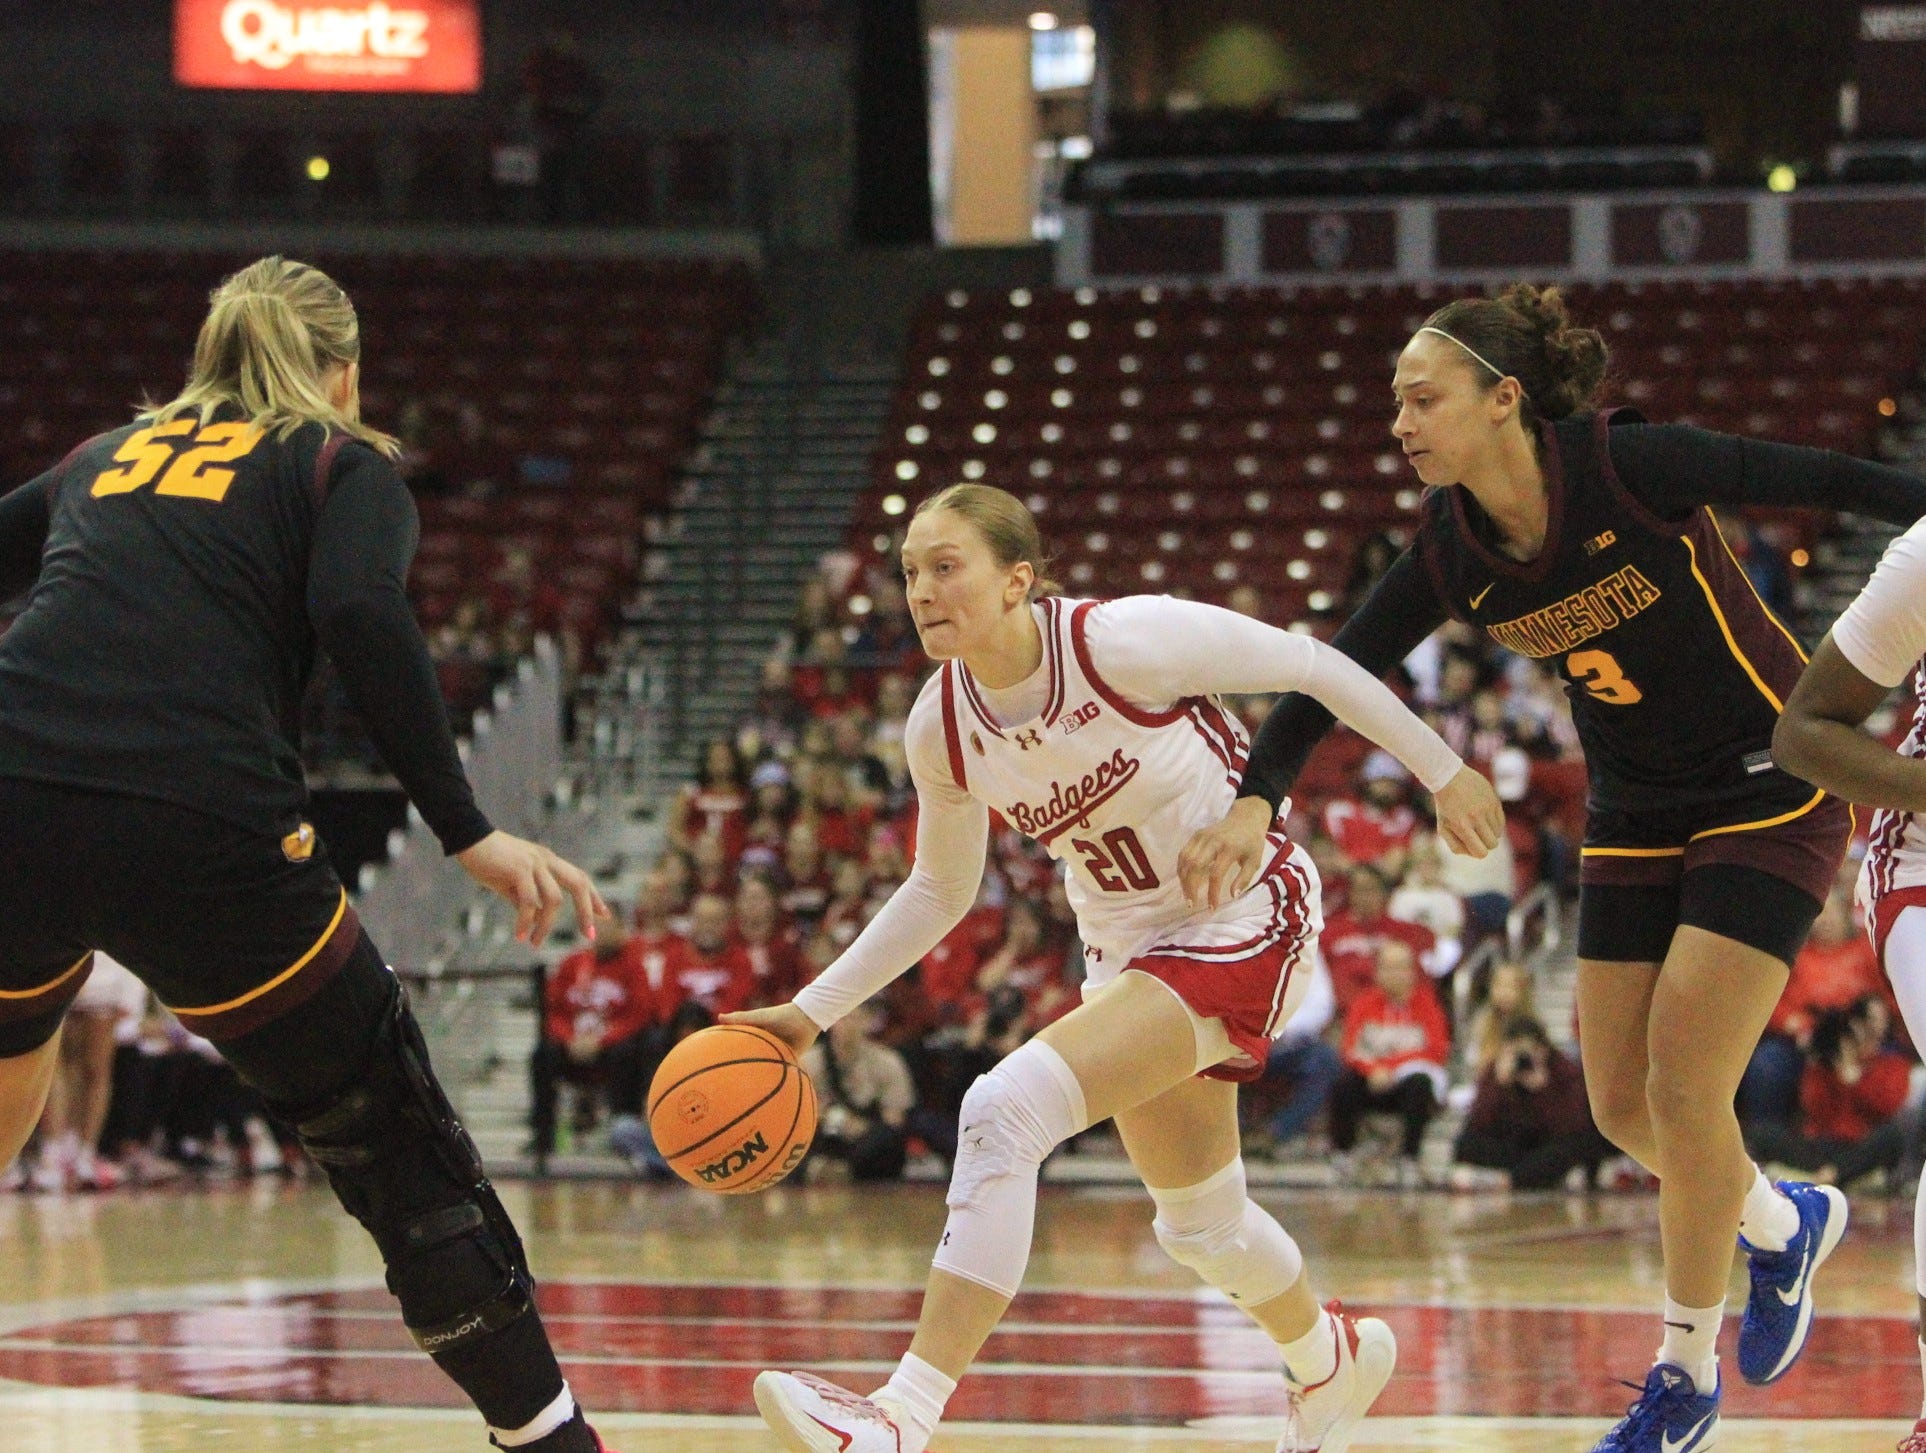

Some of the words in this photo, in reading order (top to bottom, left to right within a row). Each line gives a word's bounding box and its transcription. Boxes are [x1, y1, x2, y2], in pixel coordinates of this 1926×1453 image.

[221, 0, 429, 69] Quartz
[90, 418, 267, 502] 52
[1486, 564, 1661, 658] MINNESOTA
[1566, 649, 1643, 705] 3
[1007, 748, 1139, 842] Badgers
[1071, 826, 1160, 891] 20
[694, 1131, 768, 1183] NCAA
[423, 1314, 482, 1345] DONJOY
